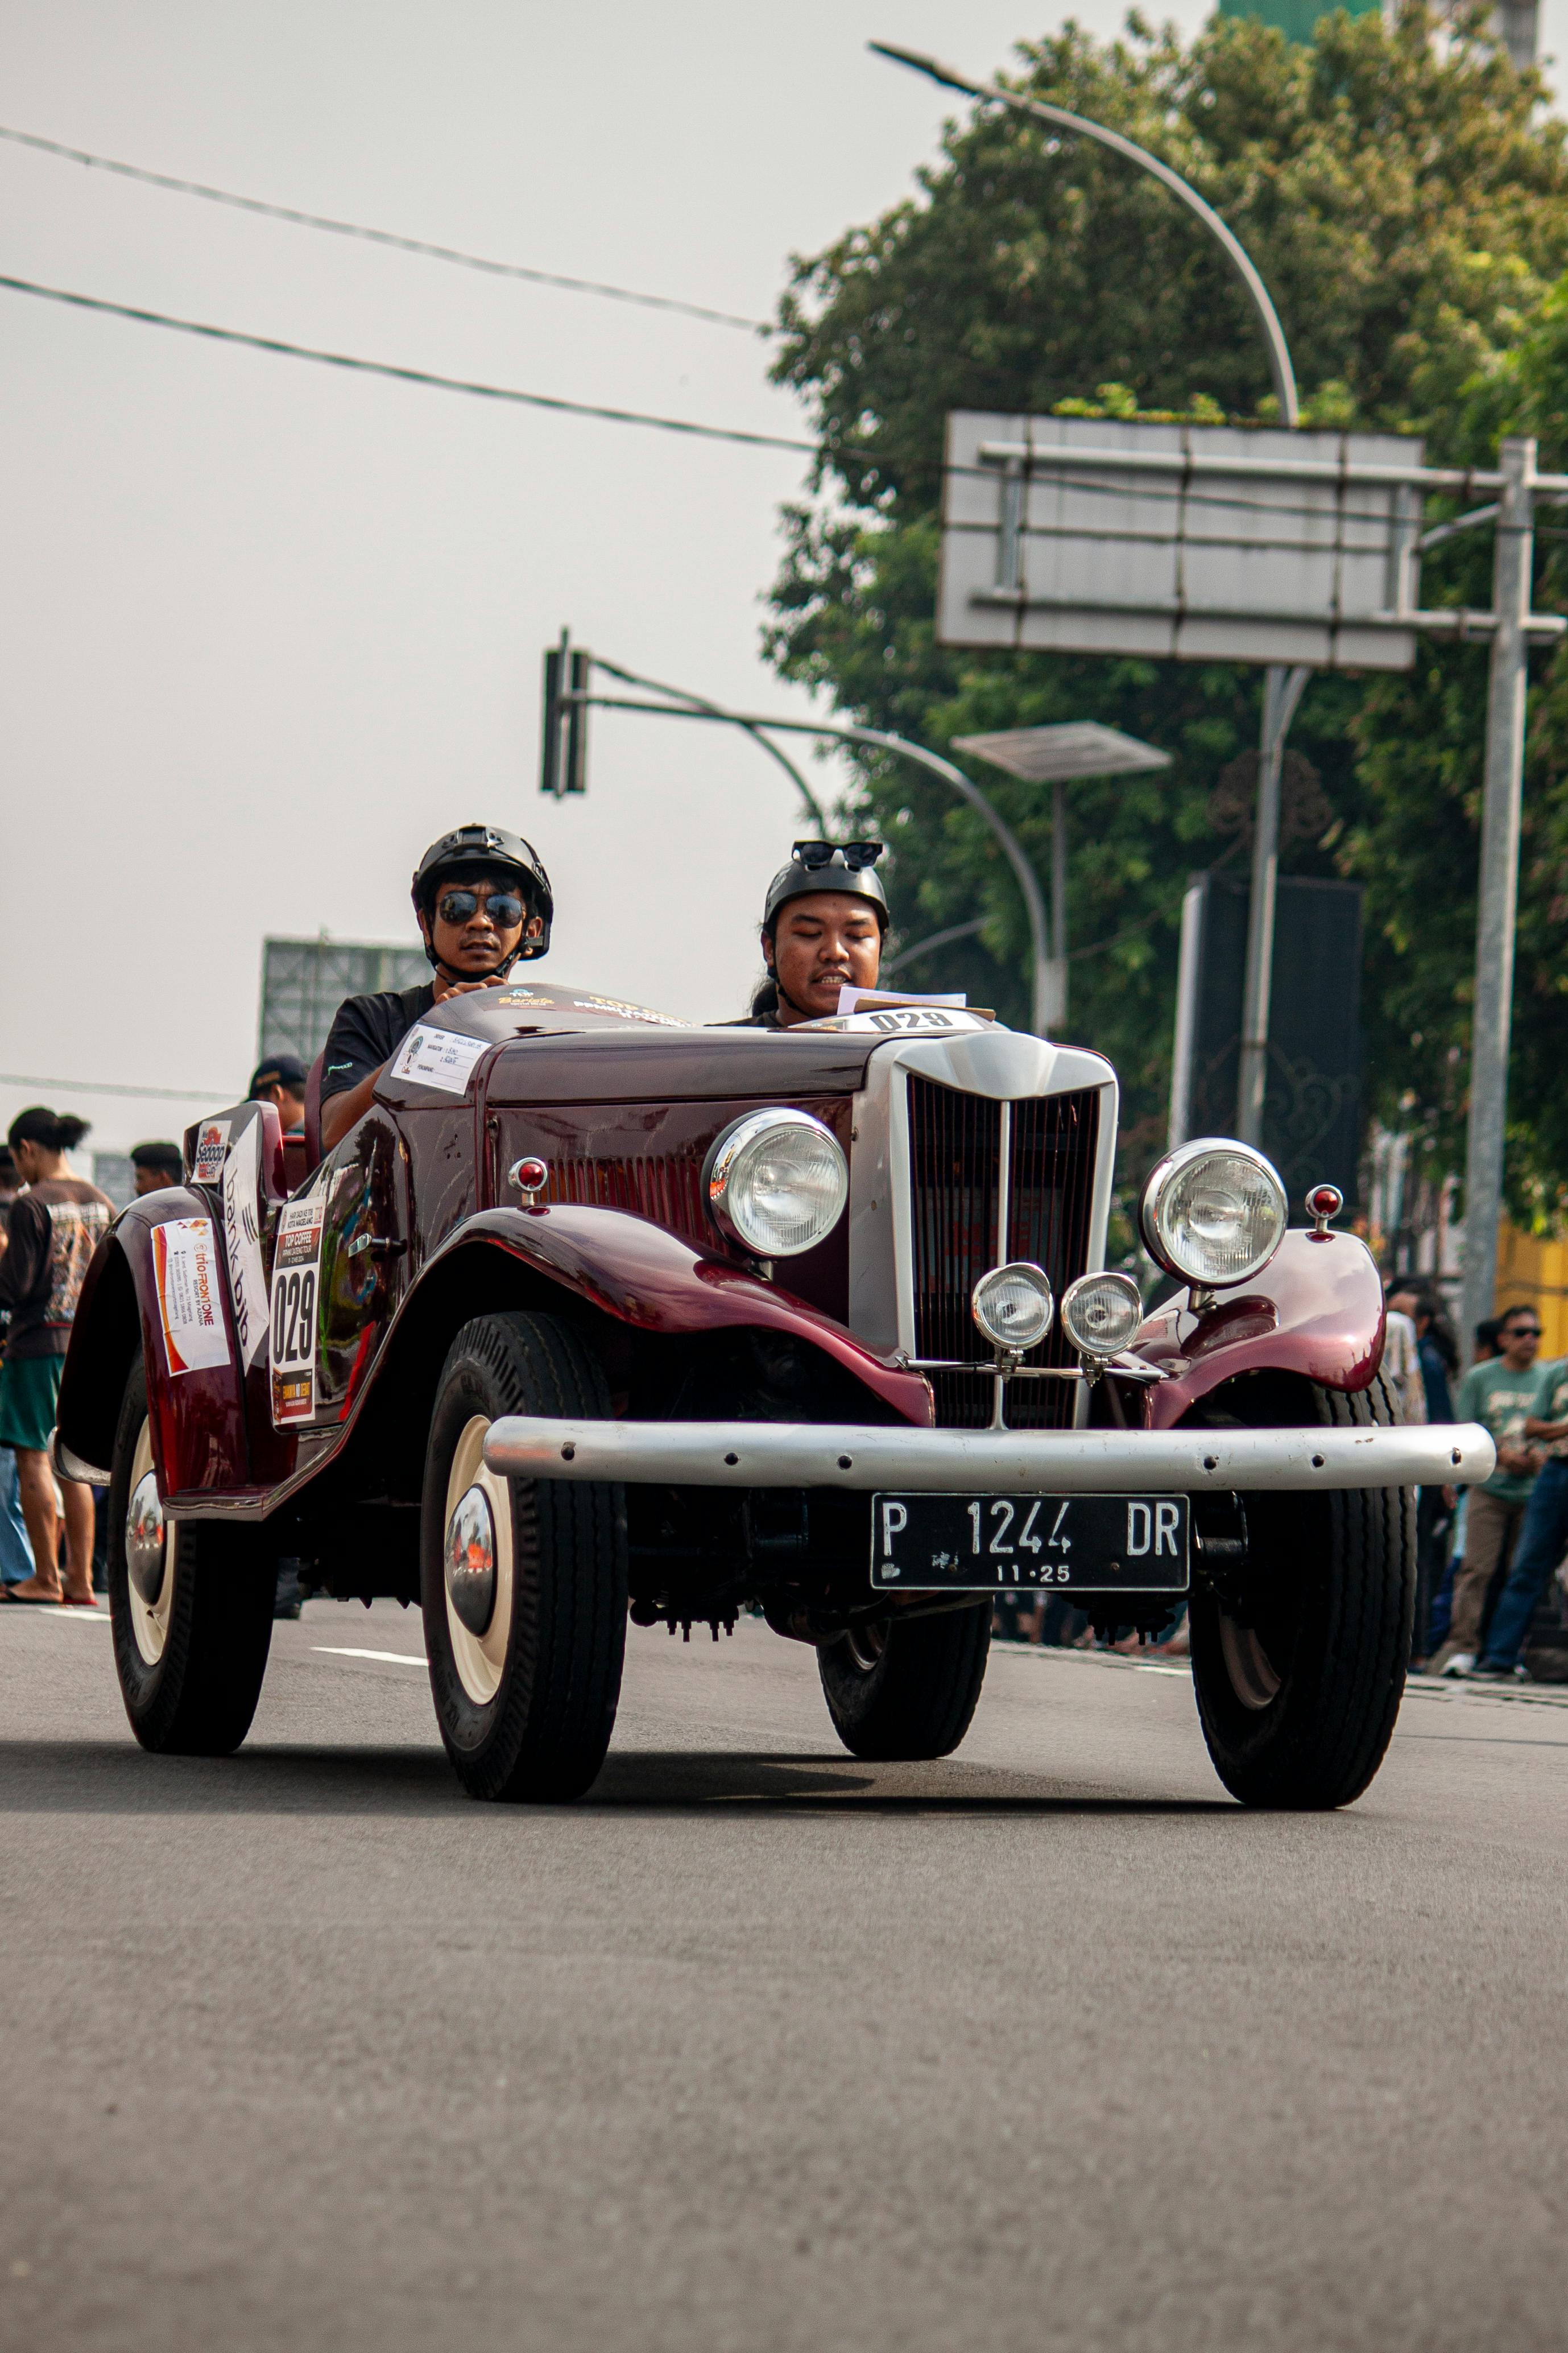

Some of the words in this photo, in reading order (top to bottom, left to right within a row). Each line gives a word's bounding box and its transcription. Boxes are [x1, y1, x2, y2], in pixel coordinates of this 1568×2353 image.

[870, 1012, 954, 1031] 029
[286, 1234, 294, 1248] TOP
[294, 1231, 312, 1246] COFFEE
[296, 1217, 313, 1227] MAGELANG
[227, 1168, 241, 1275] bank
[234, 1269, 249, 1348] bjb
[273, 1270, 315, 1364] 029
[883, 1502, 907, 1556] P
[967, 1501, 1071, 1555] 1244
[1127, 1502, 1180, 1556] DR
